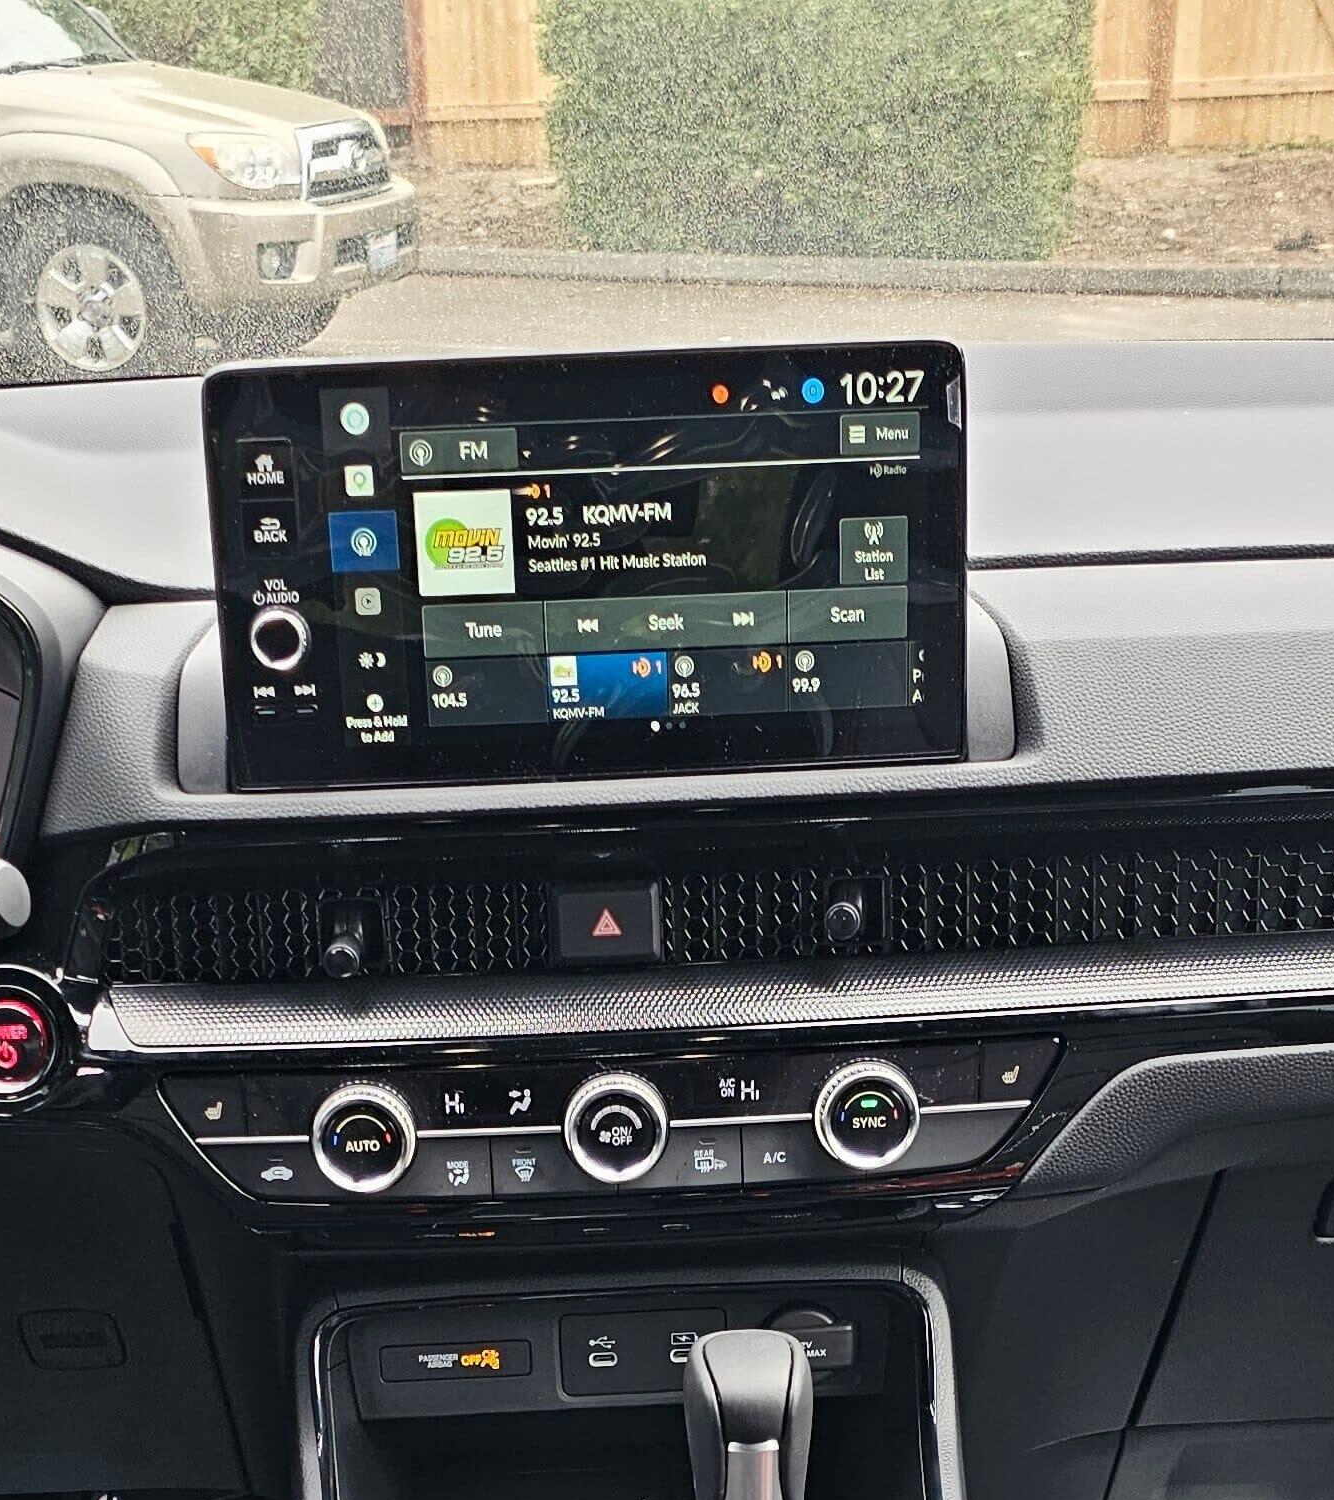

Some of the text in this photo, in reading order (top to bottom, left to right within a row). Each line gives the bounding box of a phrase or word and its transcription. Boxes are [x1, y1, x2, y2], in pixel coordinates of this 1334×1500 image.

[839, 370, 925, 405] 10:27
[875, 426, 909, 441] Menu
[459, 442, 488, 460] FM
[884, 465, 907, 476] Radio
[247, 472, 284, 485] HOME
[525, 502, 672, 526] 92.5 KQMV-FM
[254, 529, 288, 543] BACK
[527, 532, 601, 550] Movin' 92.5
[528, 551, 707, 573] Seattles #1 Hit Music Station
[854, 550, 894, 564] Station
[865, 569, 884, 581] List
[264, 579, 288, 591] VOL
[265, 592, 300, 604] AUDIO
[830, 606, 865, 623] Scan
[648, 614, 684, 631] Seek
[465, 622, 503, 639] Tune
[671, 683, 700, 699] 96.5
[792, 677, 820, 693] 99.9
[432, 692, 467, 709] 104.5
[552, 688, 580, 703] 92.5
[553, 707, 605, 720] KQMV-FM
[672, 702, 700, 715] JACK
[346, 717, 373, 729] Press
[384, 715, 408, 727] Hold
[374, 731, 394, 743] Add
[719, 1077, 735, 1088] A/C
[720, 1088, 735, 1098] ON
[851, 1115, 887, 1129] SYNC
[612, 1127, 633, 1137] ON/
[345, 1140, 381, 1152] AUTO
[612, 1136, 634, 1146] OFF
[694, 1150, 715, 1159] REAR
[763, 1150, 787, 1164] A/C
[447, 1160, 469, 1169] MODE
[512, 1158, 536, 1167] FRONT
[418, 1353, 458, 1363] PASSENGER
[461, 1354, 482, 1366] OFF
[807, 1349, 827, 1358] MAX
[427, 1361, 452, 1369] AIRBAG
